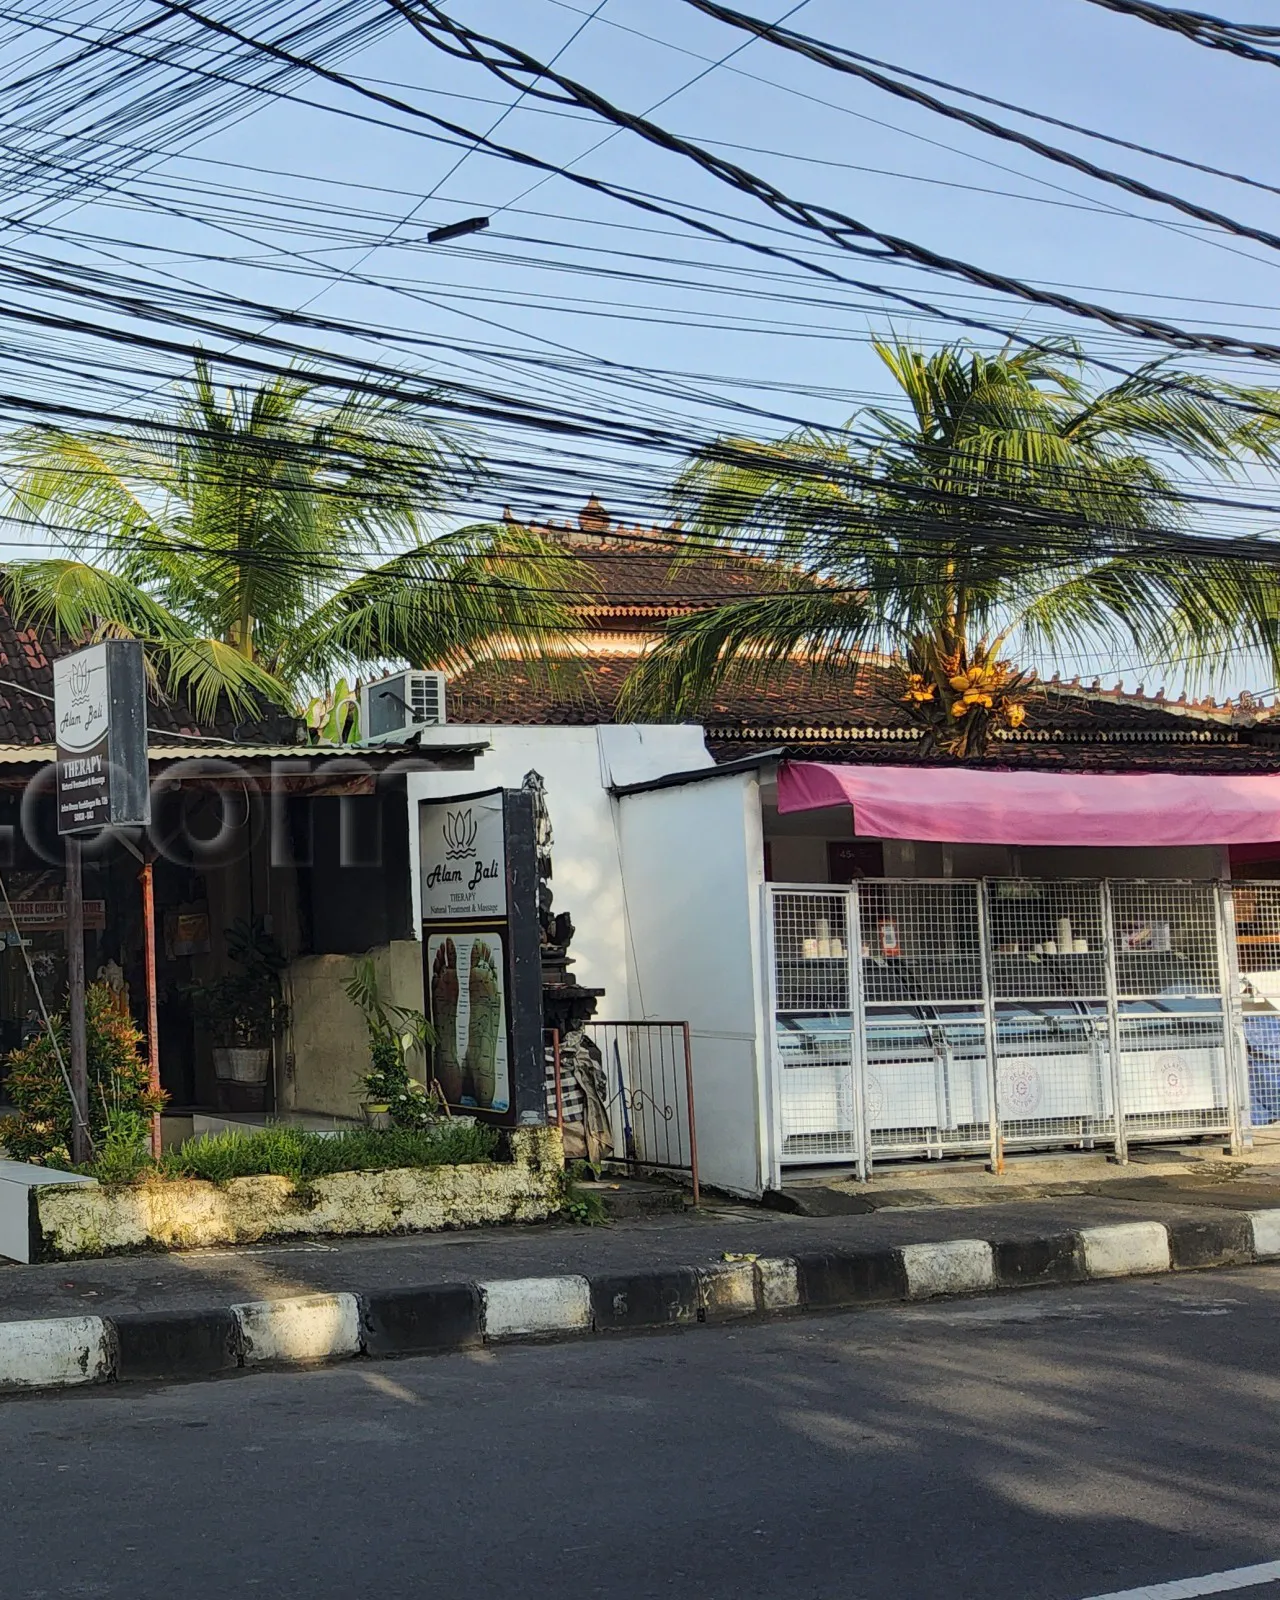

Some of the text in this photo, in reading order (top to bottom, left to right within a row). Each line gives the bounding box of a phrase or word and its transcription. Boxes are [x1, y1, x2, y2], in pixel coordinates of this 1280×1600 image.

[60, 702, 102, 733] Alam Bali
[63, 754, 103, 779] THERAPY
[426, 859, 498, 890] Alam Bali
[431, 905, 447, 914] Natural
[448, 904, 470, 913] Treatment
[478, 903, 498, 913] Massage
[450, 892, 476, 902] THERAPY
